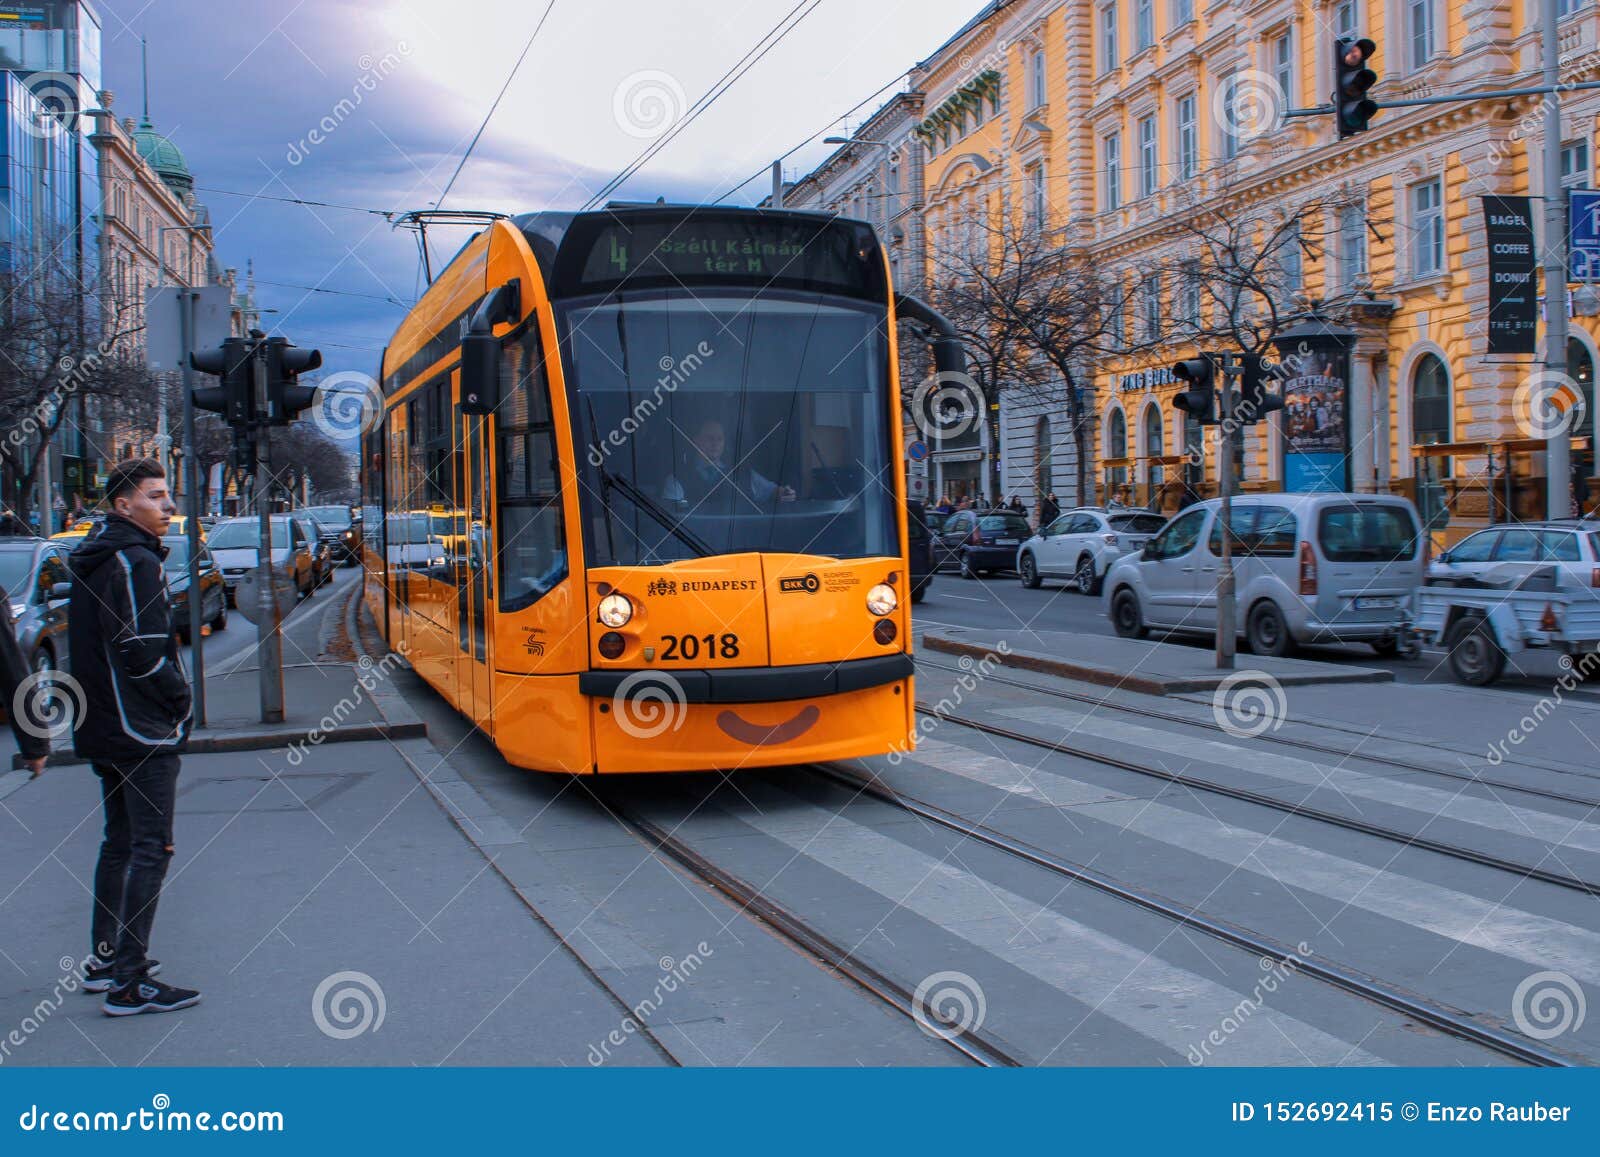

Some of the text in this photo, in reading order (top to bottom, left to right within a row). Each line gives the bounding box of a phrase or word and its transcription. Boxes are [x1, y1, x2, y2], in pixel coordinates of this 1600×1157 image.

[1490, 215, 1526, 225] BAGEL
[610, 234, 803, 272] 4 Széll Kálmán
[1494, 244, 1529, 254] COFFEE
[704, 256, 762, 272] tér M
[1495, 273, 1530, 283] DONUT
[1490, 321, 1535, 329] THE BOX
[1144, 366, 1182, 387] BURG
[681, 579, 758, 592] BUDAPEST
[660, 633, 739, 661] 2018
